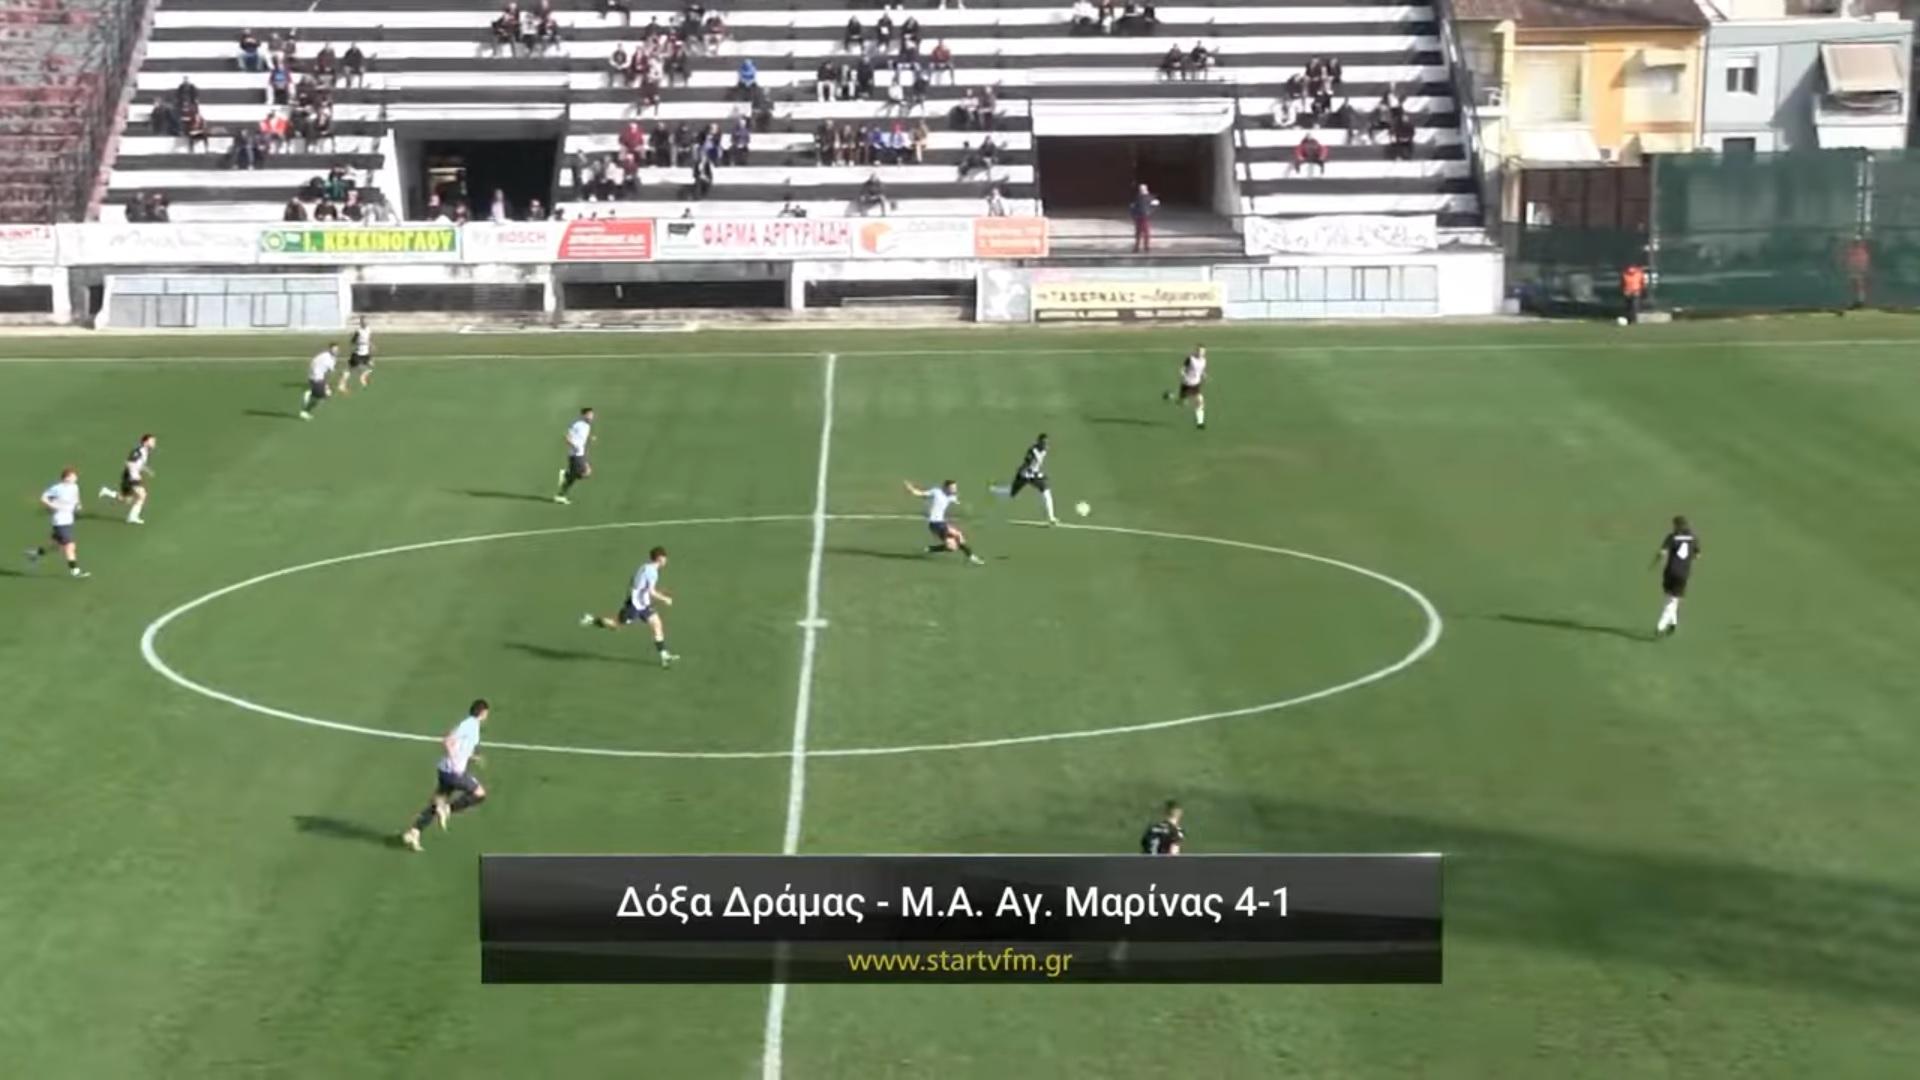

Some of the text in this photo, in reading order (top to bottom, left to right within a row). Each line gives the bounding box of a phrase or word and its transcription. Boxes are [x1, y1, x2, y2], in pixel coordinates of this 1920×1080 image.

[496, 231, 547, 245] BOSCH
[702, 222, 850, 246] ΦΑΡΜΑ ΑΡΓΥΡΙΑΔΗ
[1676, 542, 1690, 560] 4
